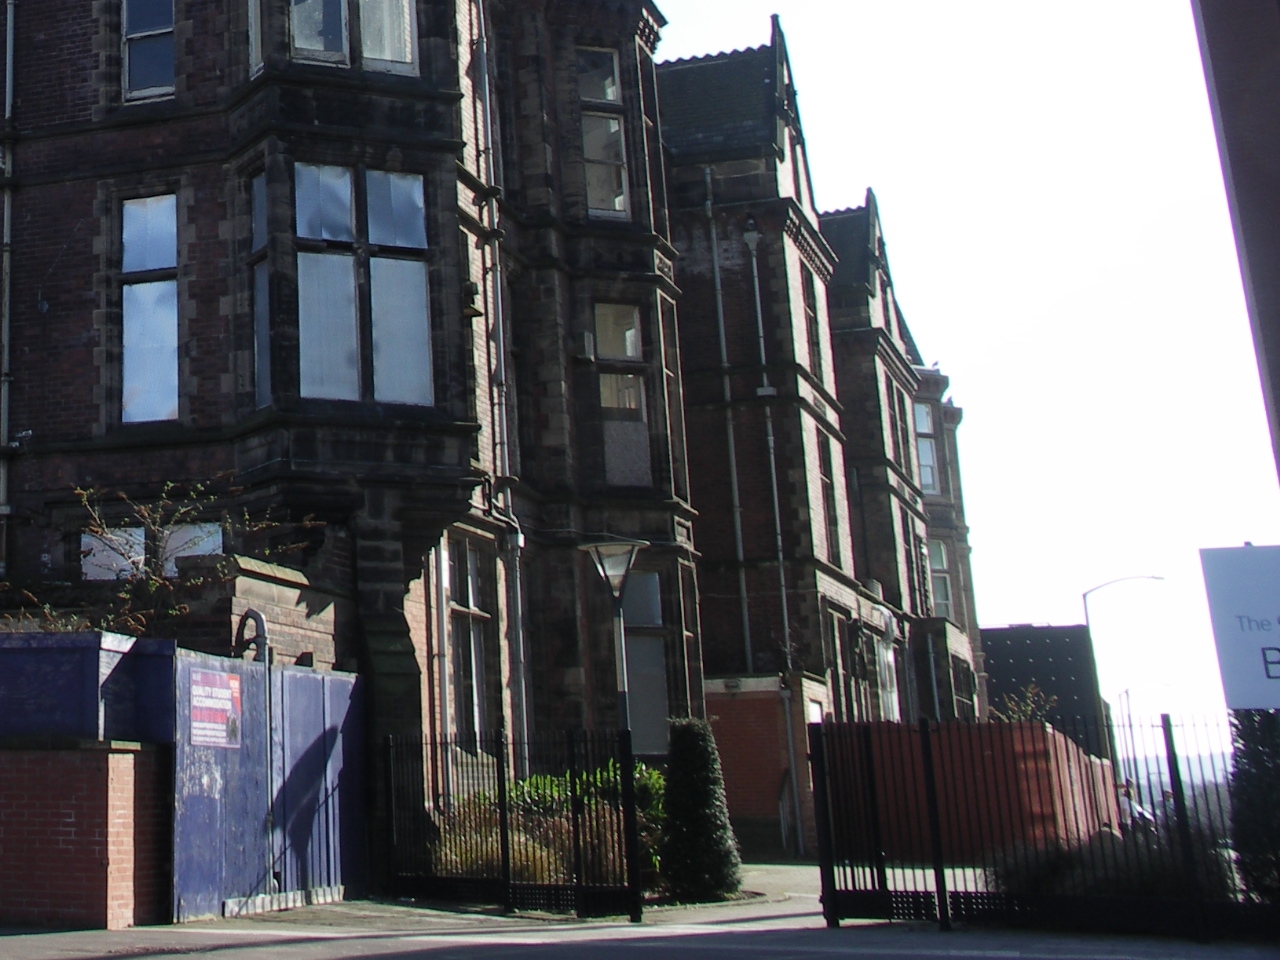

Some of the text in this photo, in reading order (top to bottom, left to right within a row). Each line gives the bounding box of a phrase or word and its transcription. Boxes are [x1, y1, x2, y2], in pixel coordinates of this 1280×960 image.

[1235, 615, 1272, 632] The
[192, 685, 212, 697] QUALITY
[212, 687, 232, 700] STUDENT
[192, 696, 232, 710] ACCOMMODATION
